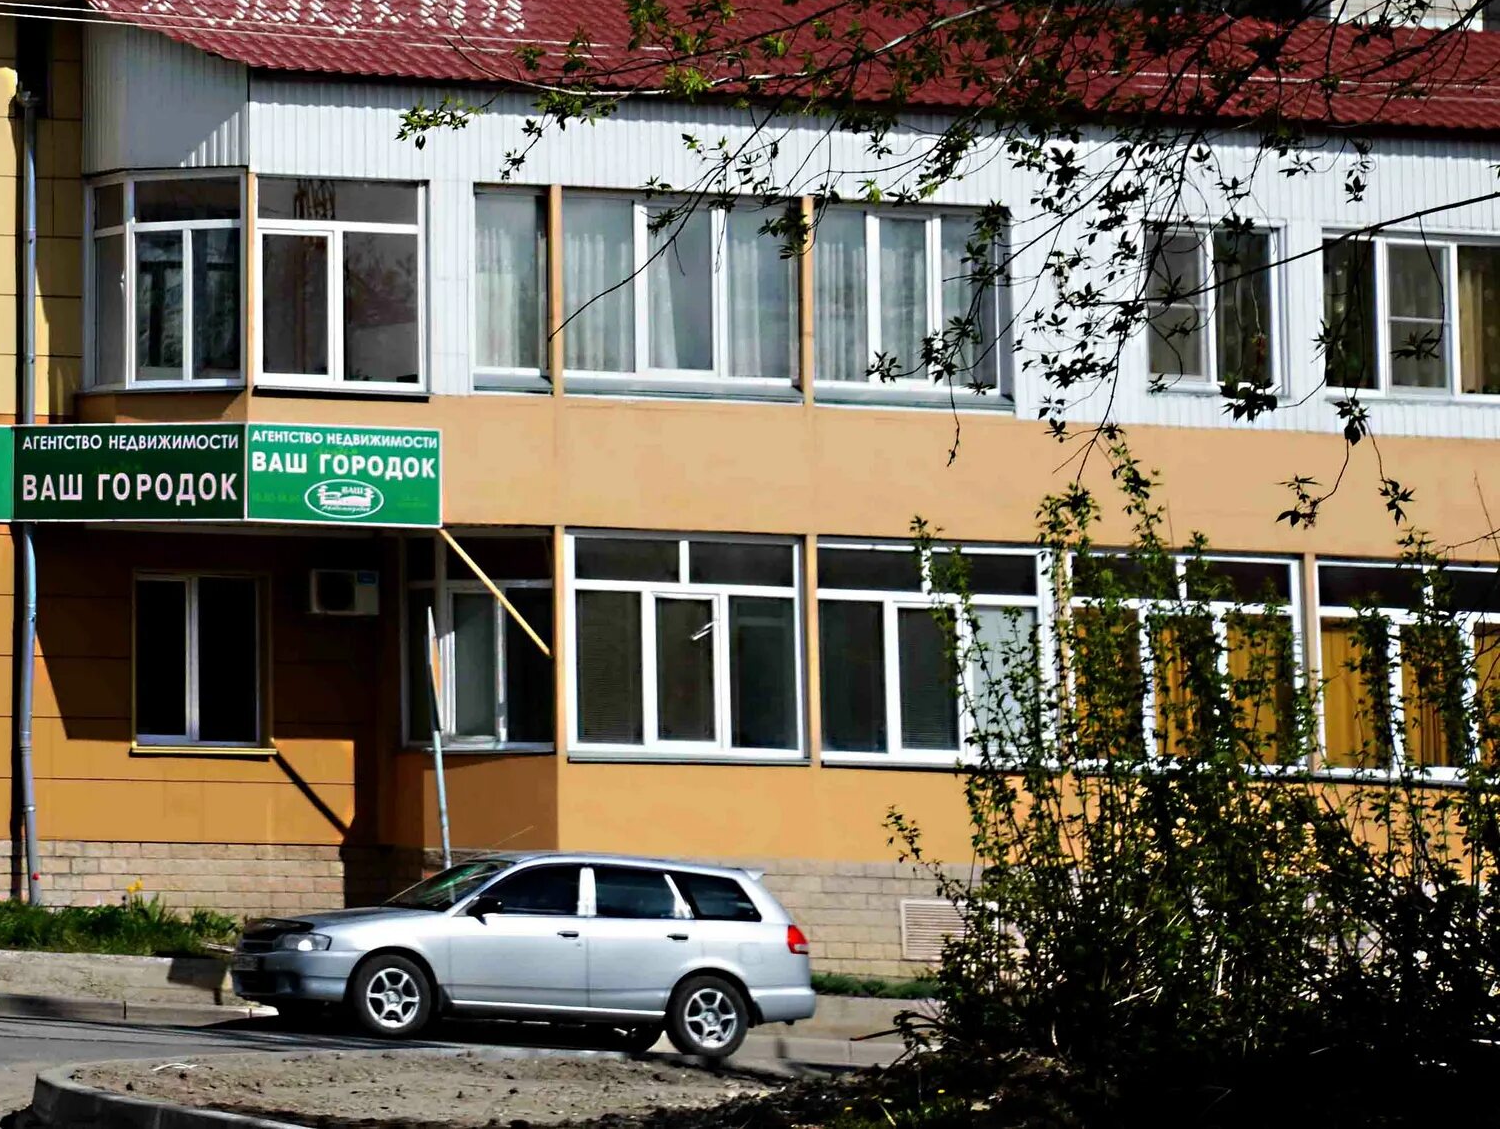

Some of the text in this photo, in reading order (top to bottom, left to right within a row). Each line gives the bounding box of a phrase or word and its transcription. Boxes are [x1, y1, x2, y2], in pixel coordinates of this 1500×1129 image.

[22, 434, 239, 452] АГЕНТСТВО НЕДВИЖИМОСТИ
[251, 430, 438, 449] АГЕНТСТВО НЕДВИЖИМОСТИ
[252, 452, 436, 481] ВАШ ГОРОДОК
[23, 472, 238, 506] ВАШ ГОРОДОК
